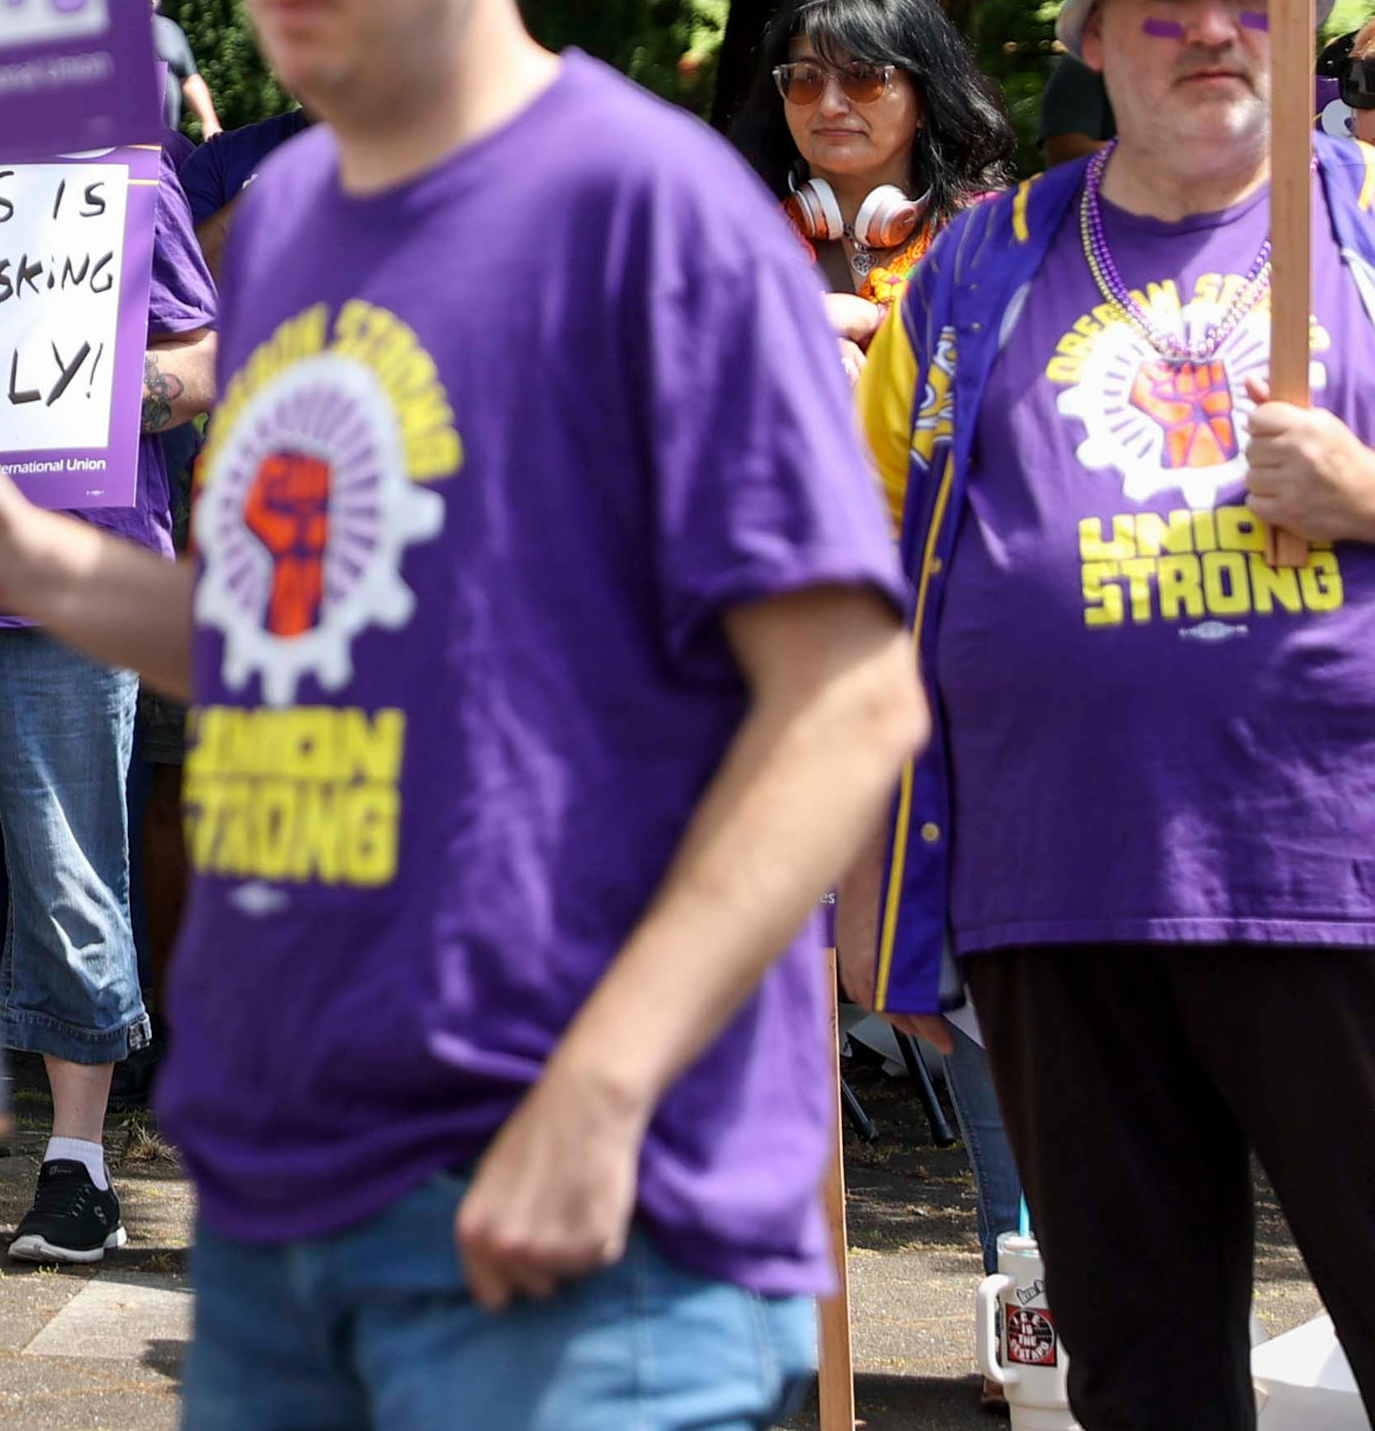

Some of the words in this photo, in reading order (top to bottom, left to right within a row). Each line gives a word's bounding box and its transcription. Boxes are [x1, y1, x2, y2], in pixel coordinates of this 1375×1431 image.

[53, 177, 106, 220] IS
[66, 458, 107, 472] Union
[1078, 506, 1267, 562] UNIO
[1080, 549, 1345, 626] STRONG
[1018, 1334, 1037, 1347] THE
